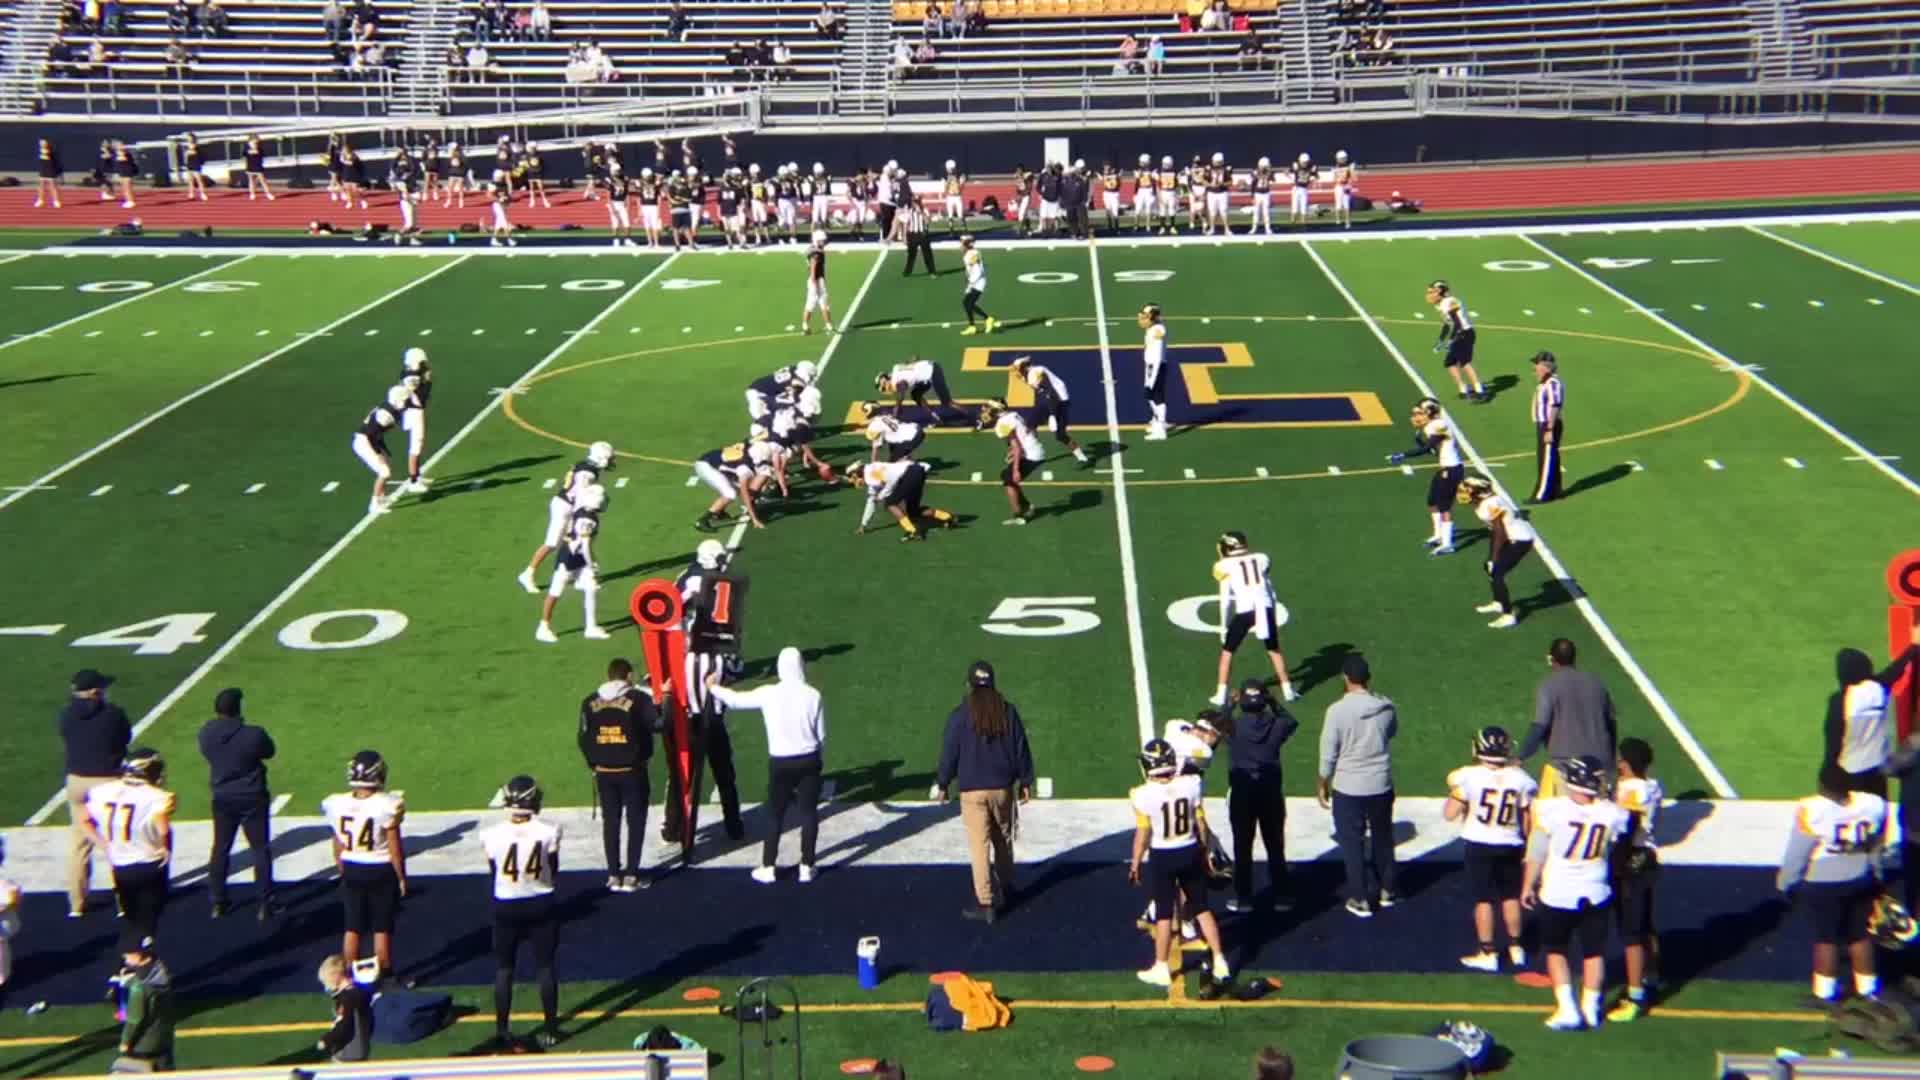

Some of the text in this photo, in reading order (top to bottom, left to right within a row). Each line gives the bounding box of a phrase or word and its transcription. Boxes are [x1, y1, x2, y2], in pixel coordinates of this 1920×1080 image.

[1239, 560, 1260, 586] 11
[711, 580, 731, 624] 1
[104, 801, 136, 842] 77
[1161, 798, 1190, 839] 18
[1477, 787, 1520, 826] 56
[340, 815, 375, 851] 54
[1564, 821, 1607, 860] 70
[503, 840, 543, 883] 44
